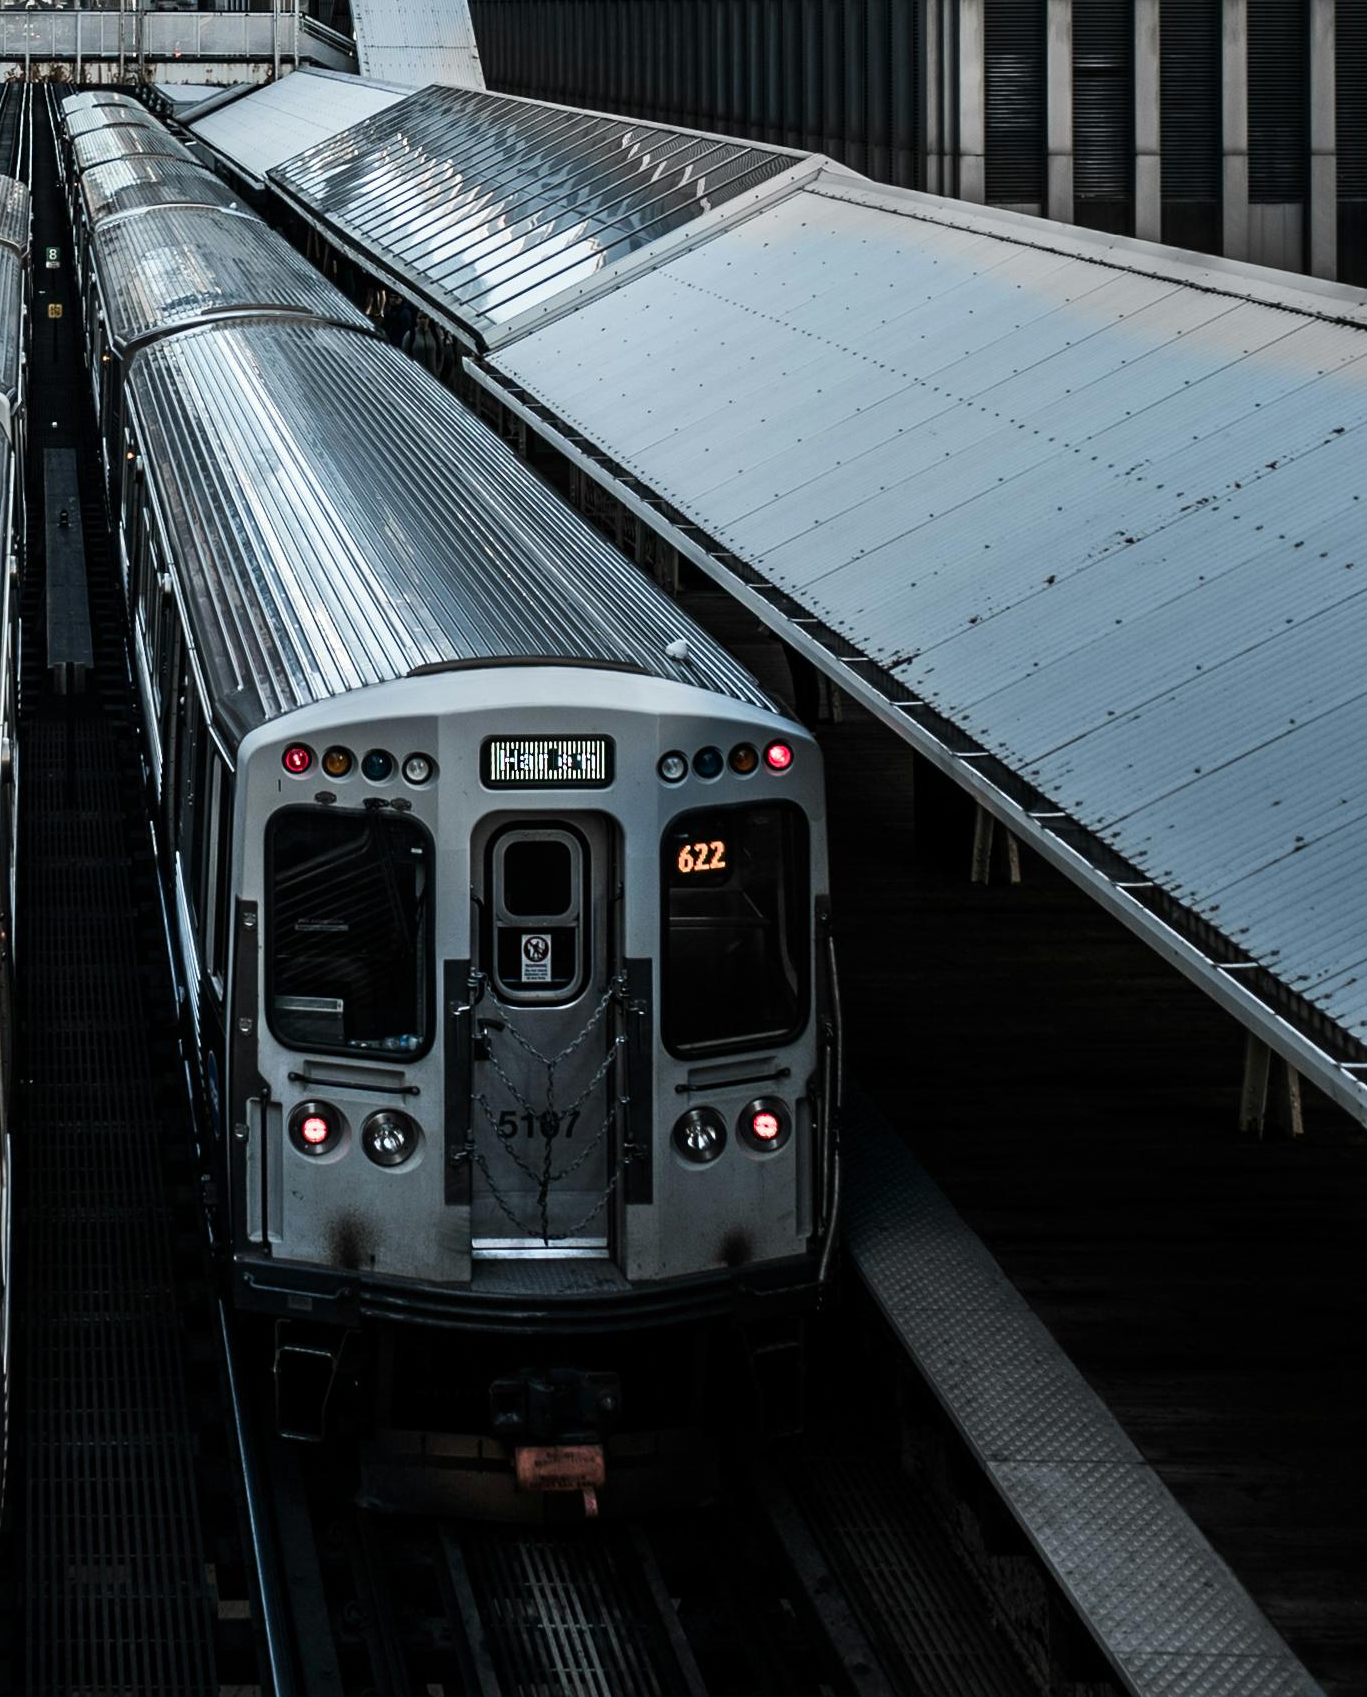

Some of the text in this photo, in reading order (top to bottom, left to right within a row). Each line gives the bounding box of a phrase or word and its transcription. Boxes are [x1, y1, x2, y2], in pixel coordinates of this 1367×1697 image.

[48, 248, 58, 260] 8
[499, 748, 596, 772] Harem
[678, 840, 726, 873] 622
[498, 1110, 581, 1139] 5107
